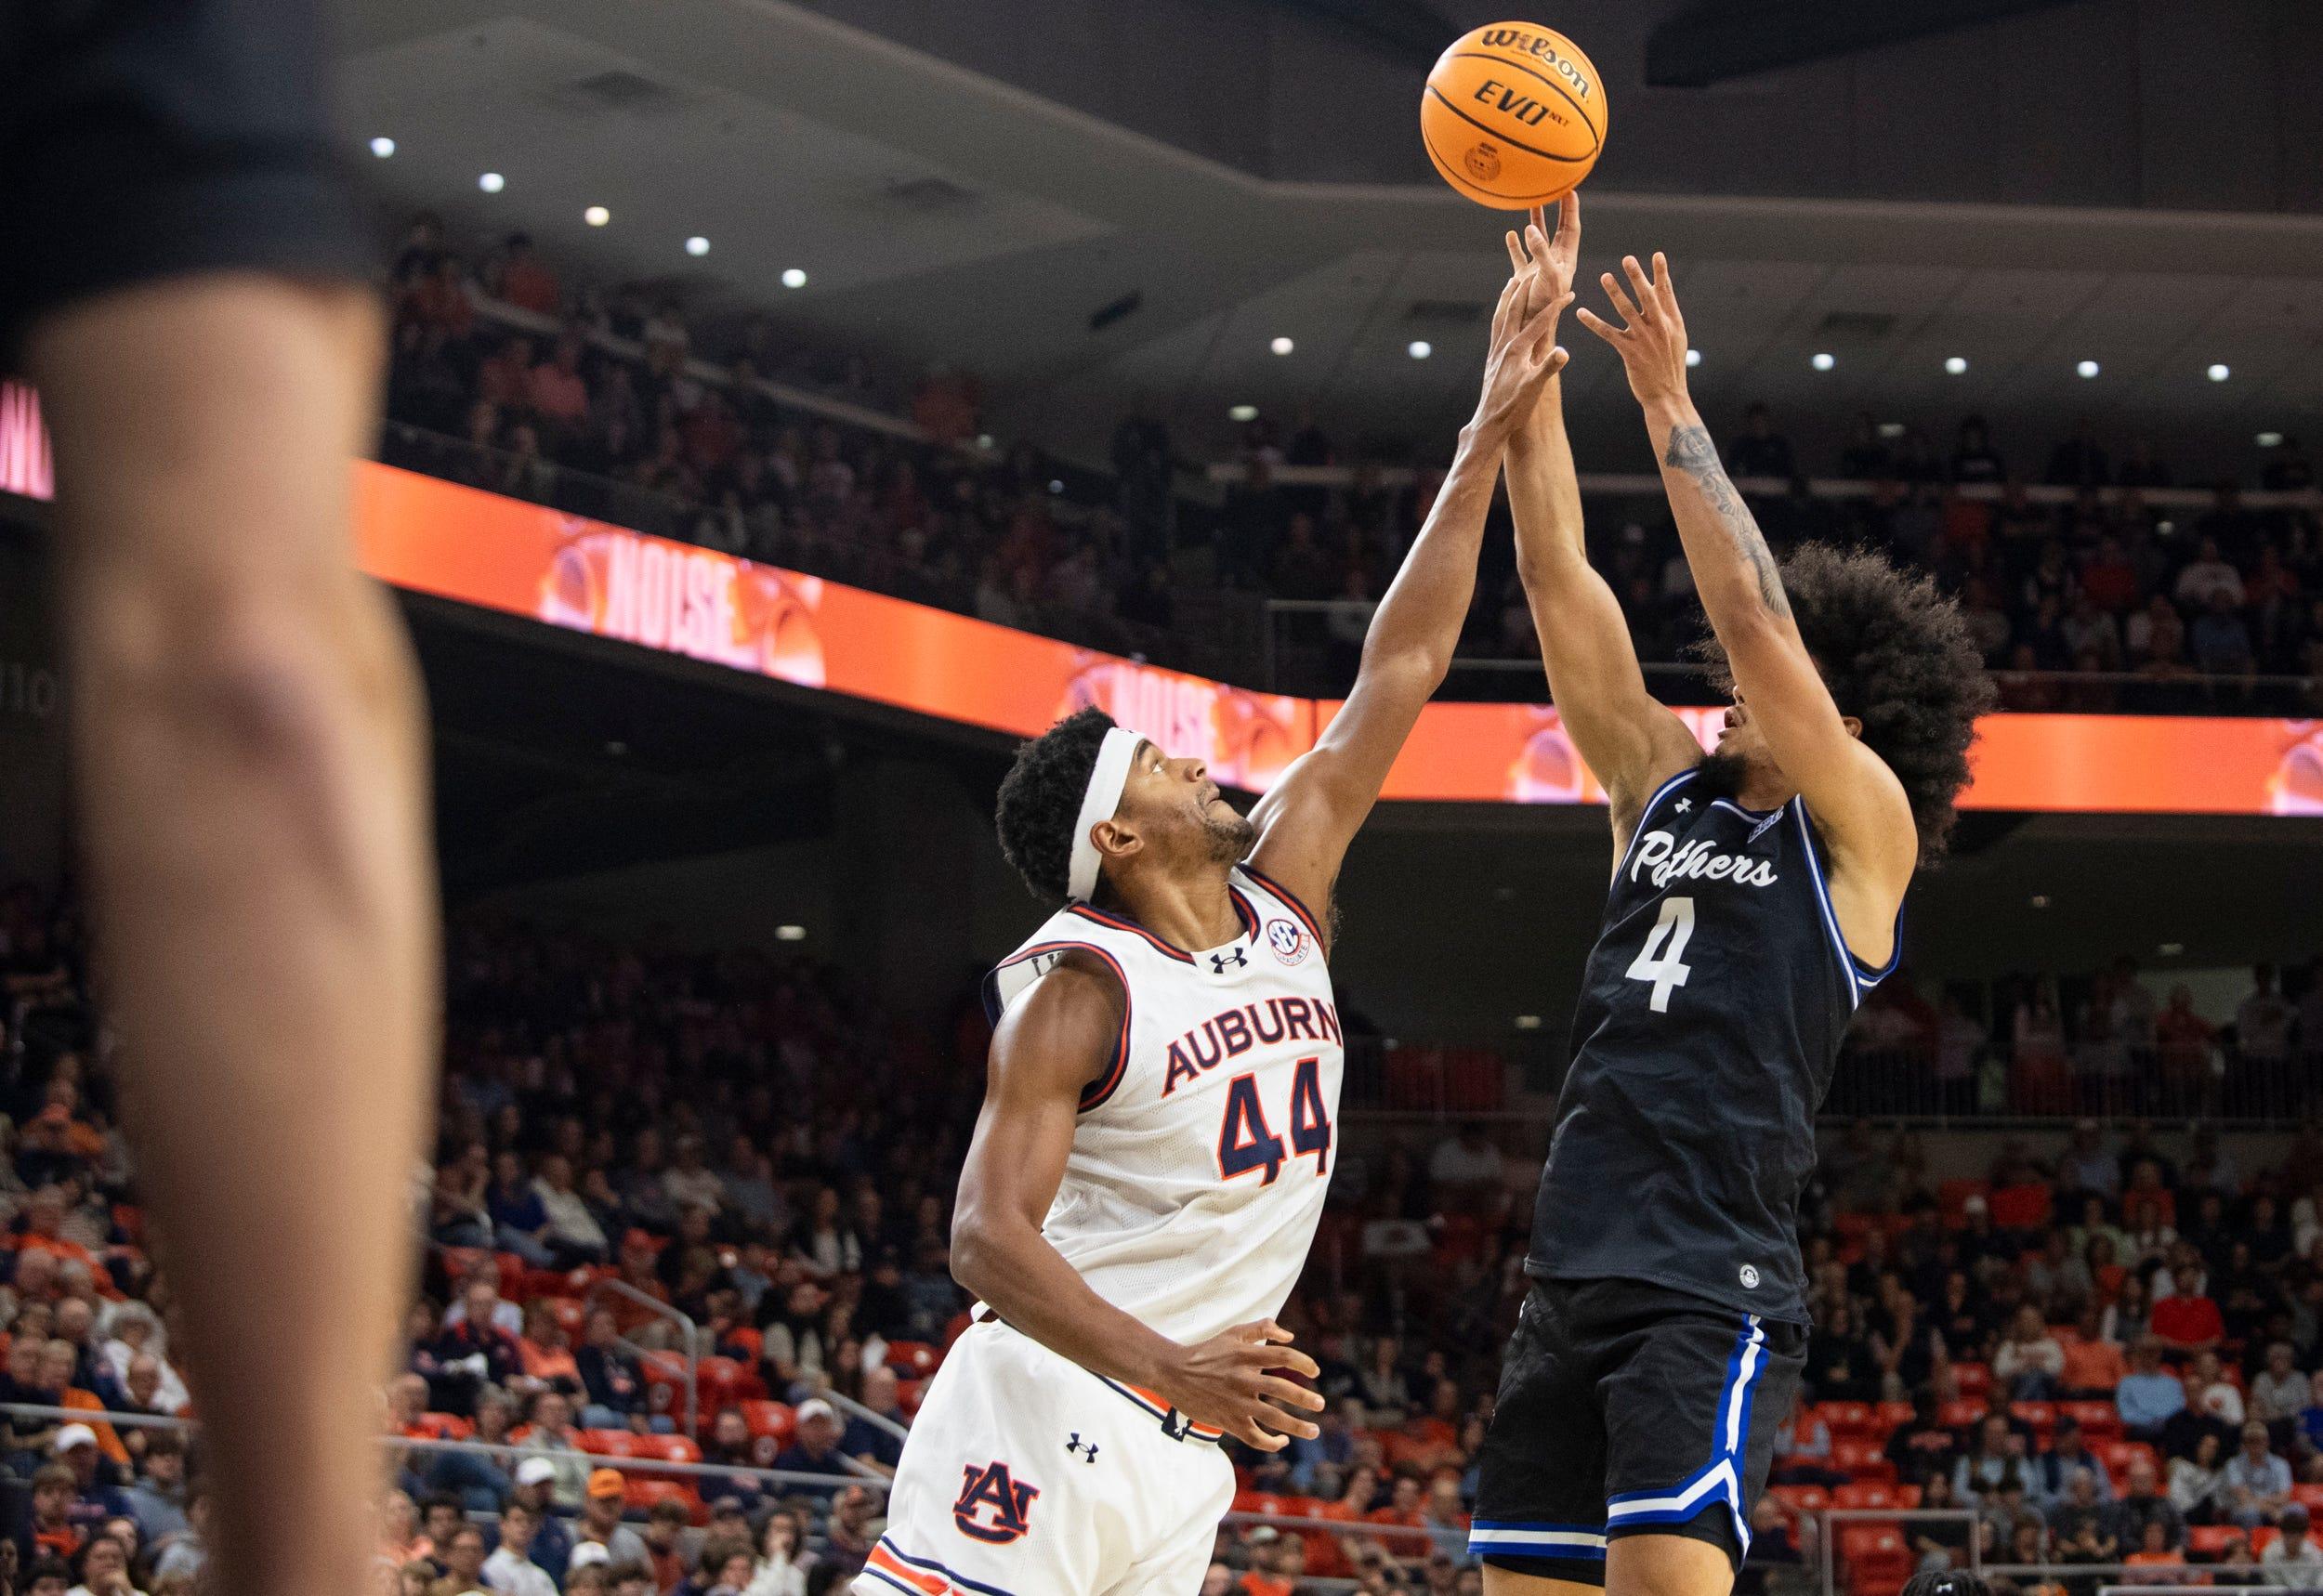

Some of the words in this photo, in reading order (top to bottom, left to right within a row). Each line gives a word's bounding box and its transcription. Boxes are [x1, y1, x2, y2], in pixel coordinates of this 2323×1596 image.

[1474, 79, 1550, 126] EVO
[1481, 29, 1590, 99] Wilson
[604, 533, 738, 660] NOISE
[1625, 896, 1695, 1013] 4
[1162, 997, 1343, 1099] AUBURN
[1217, 1056, 1332, 1187] 44
